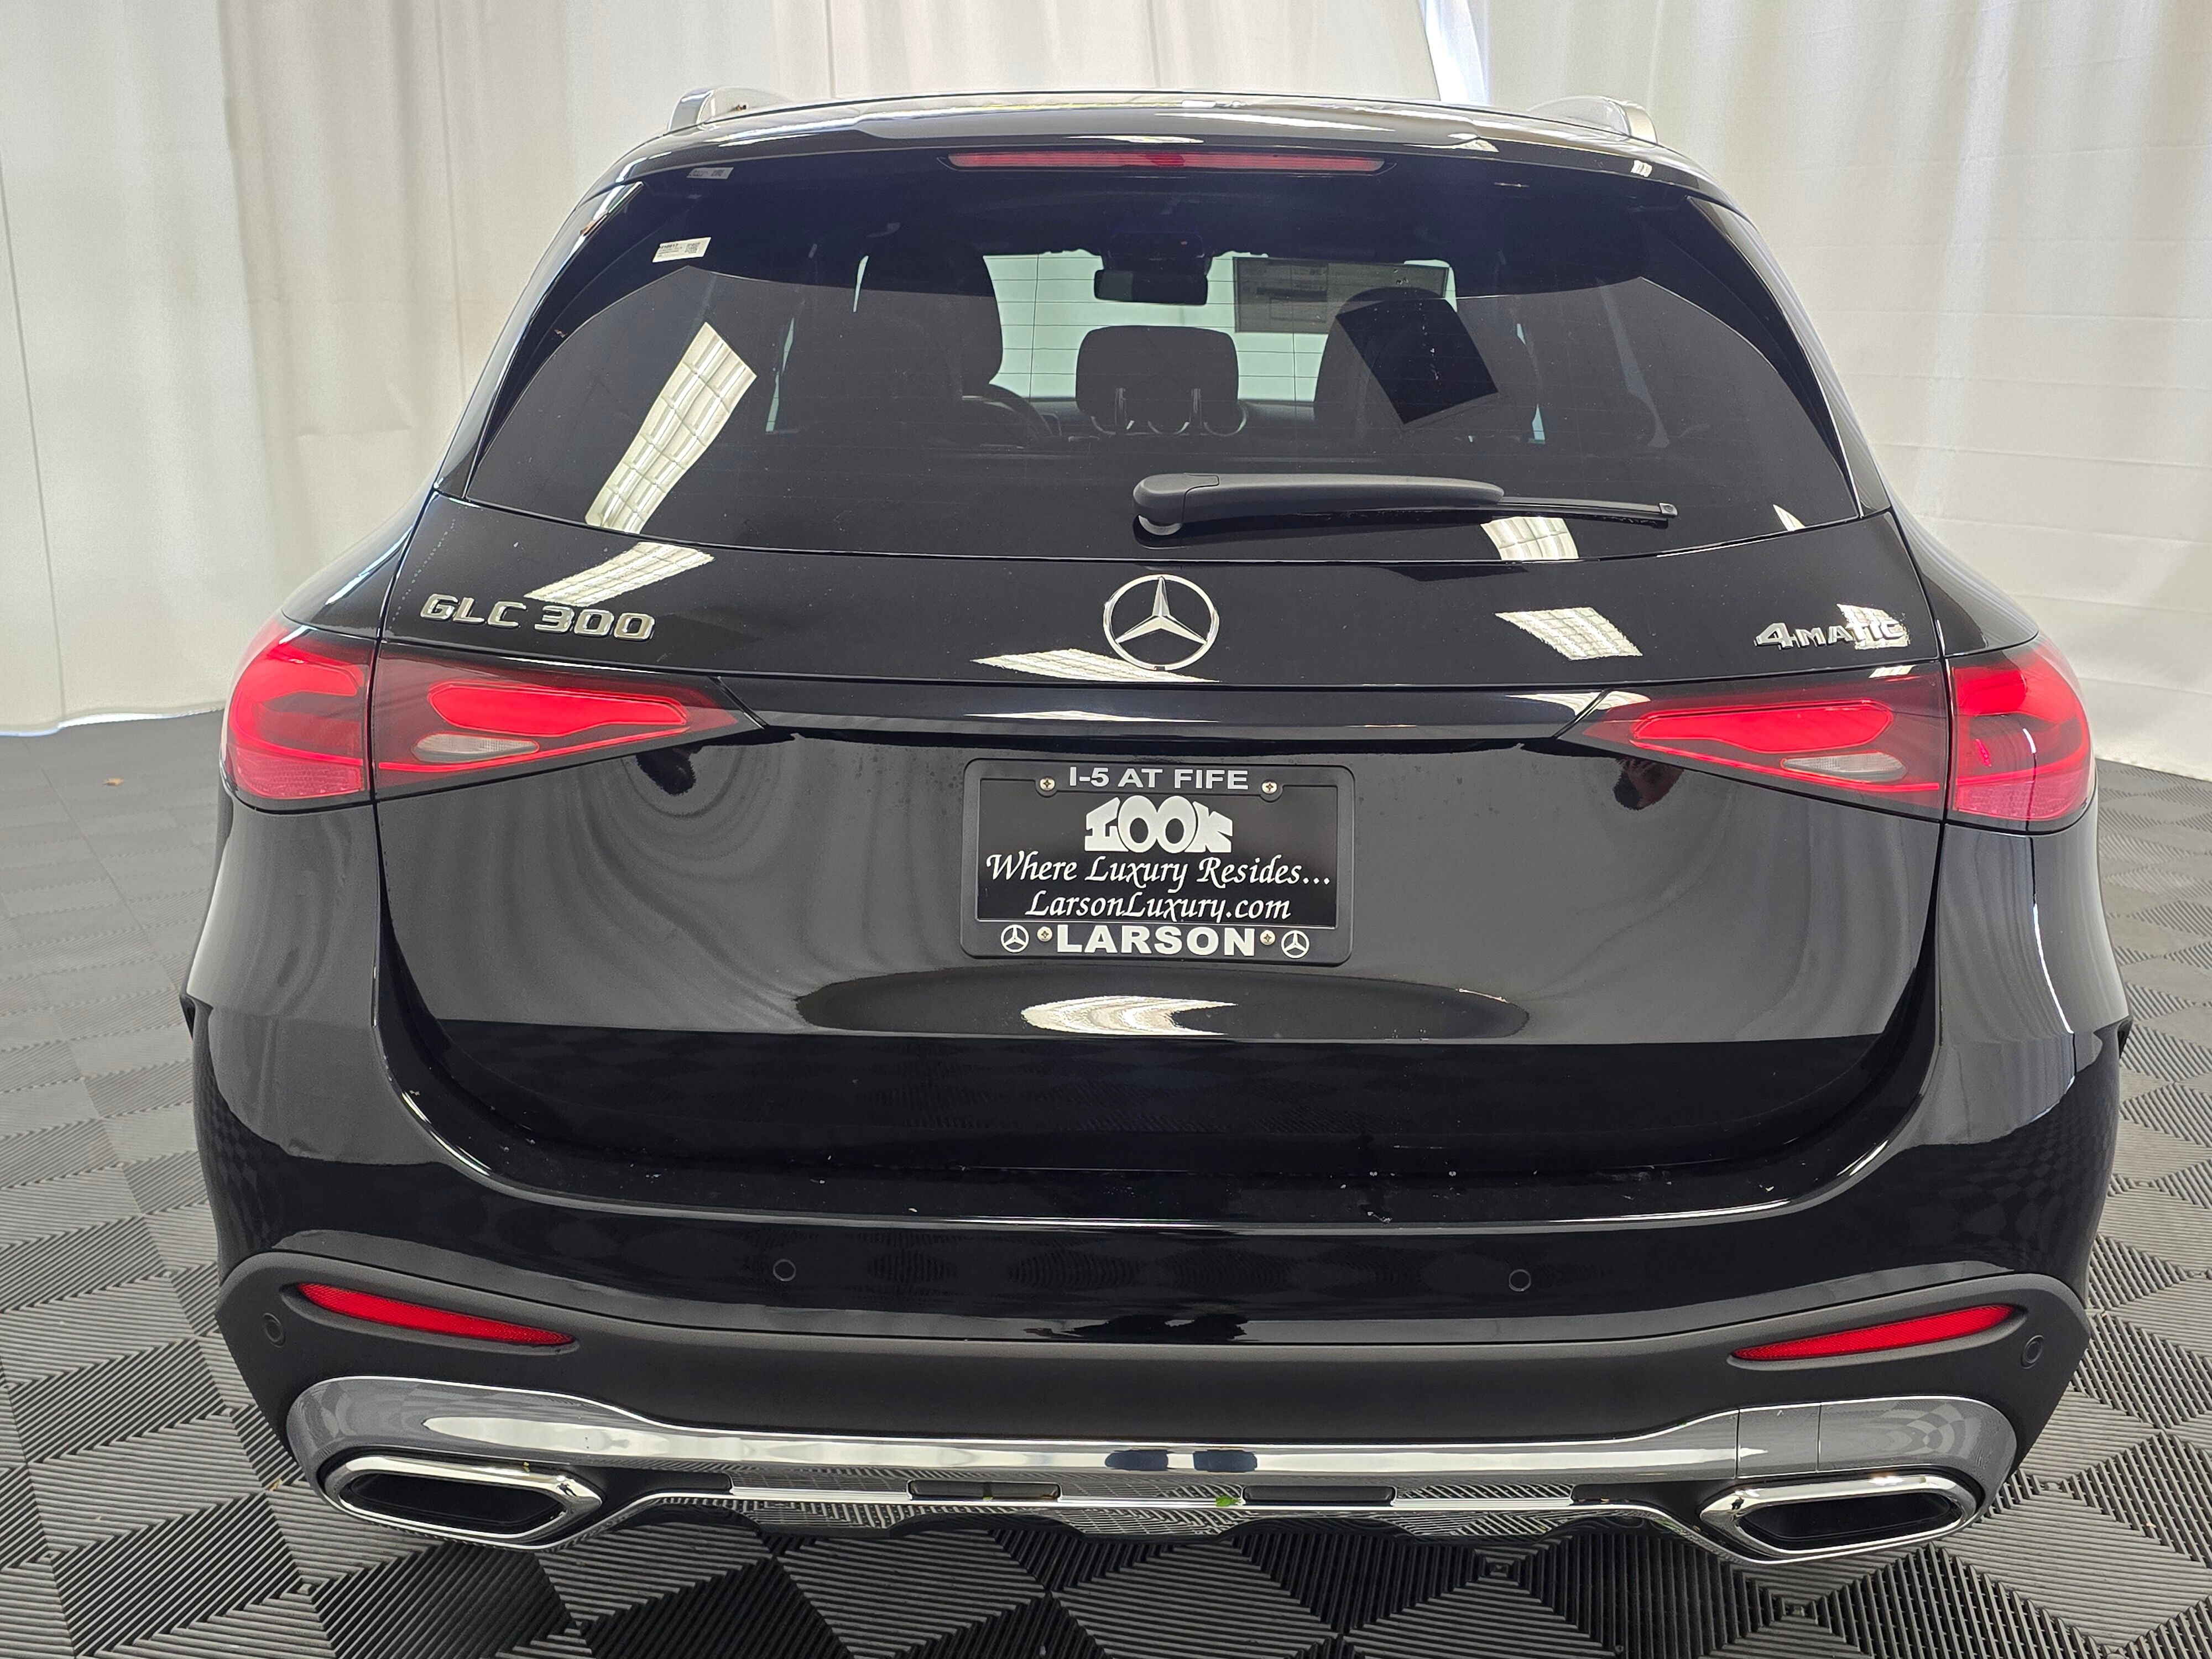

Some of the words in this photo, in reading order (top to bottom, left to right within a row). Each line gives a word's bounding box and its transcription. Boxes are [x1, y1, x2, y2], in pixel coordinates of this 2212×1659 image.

[420, 593, 527, 628] GLC
[534, 606, 656, 641] 300
[1069, 766, 1109, 787] I-5
[1118, 768, 1163, 788] AT
[1174, 769, 1249, 790] FIFE
[986, 850, 1077, 881] Where
[1084, 855, 1187, 893] Luxury
[1196, 854, 1331, 889] Resides...
[1025, 890, 1291, 923] LarsonLuxury.com
[1057, 924, 1255, 956] LARSON
